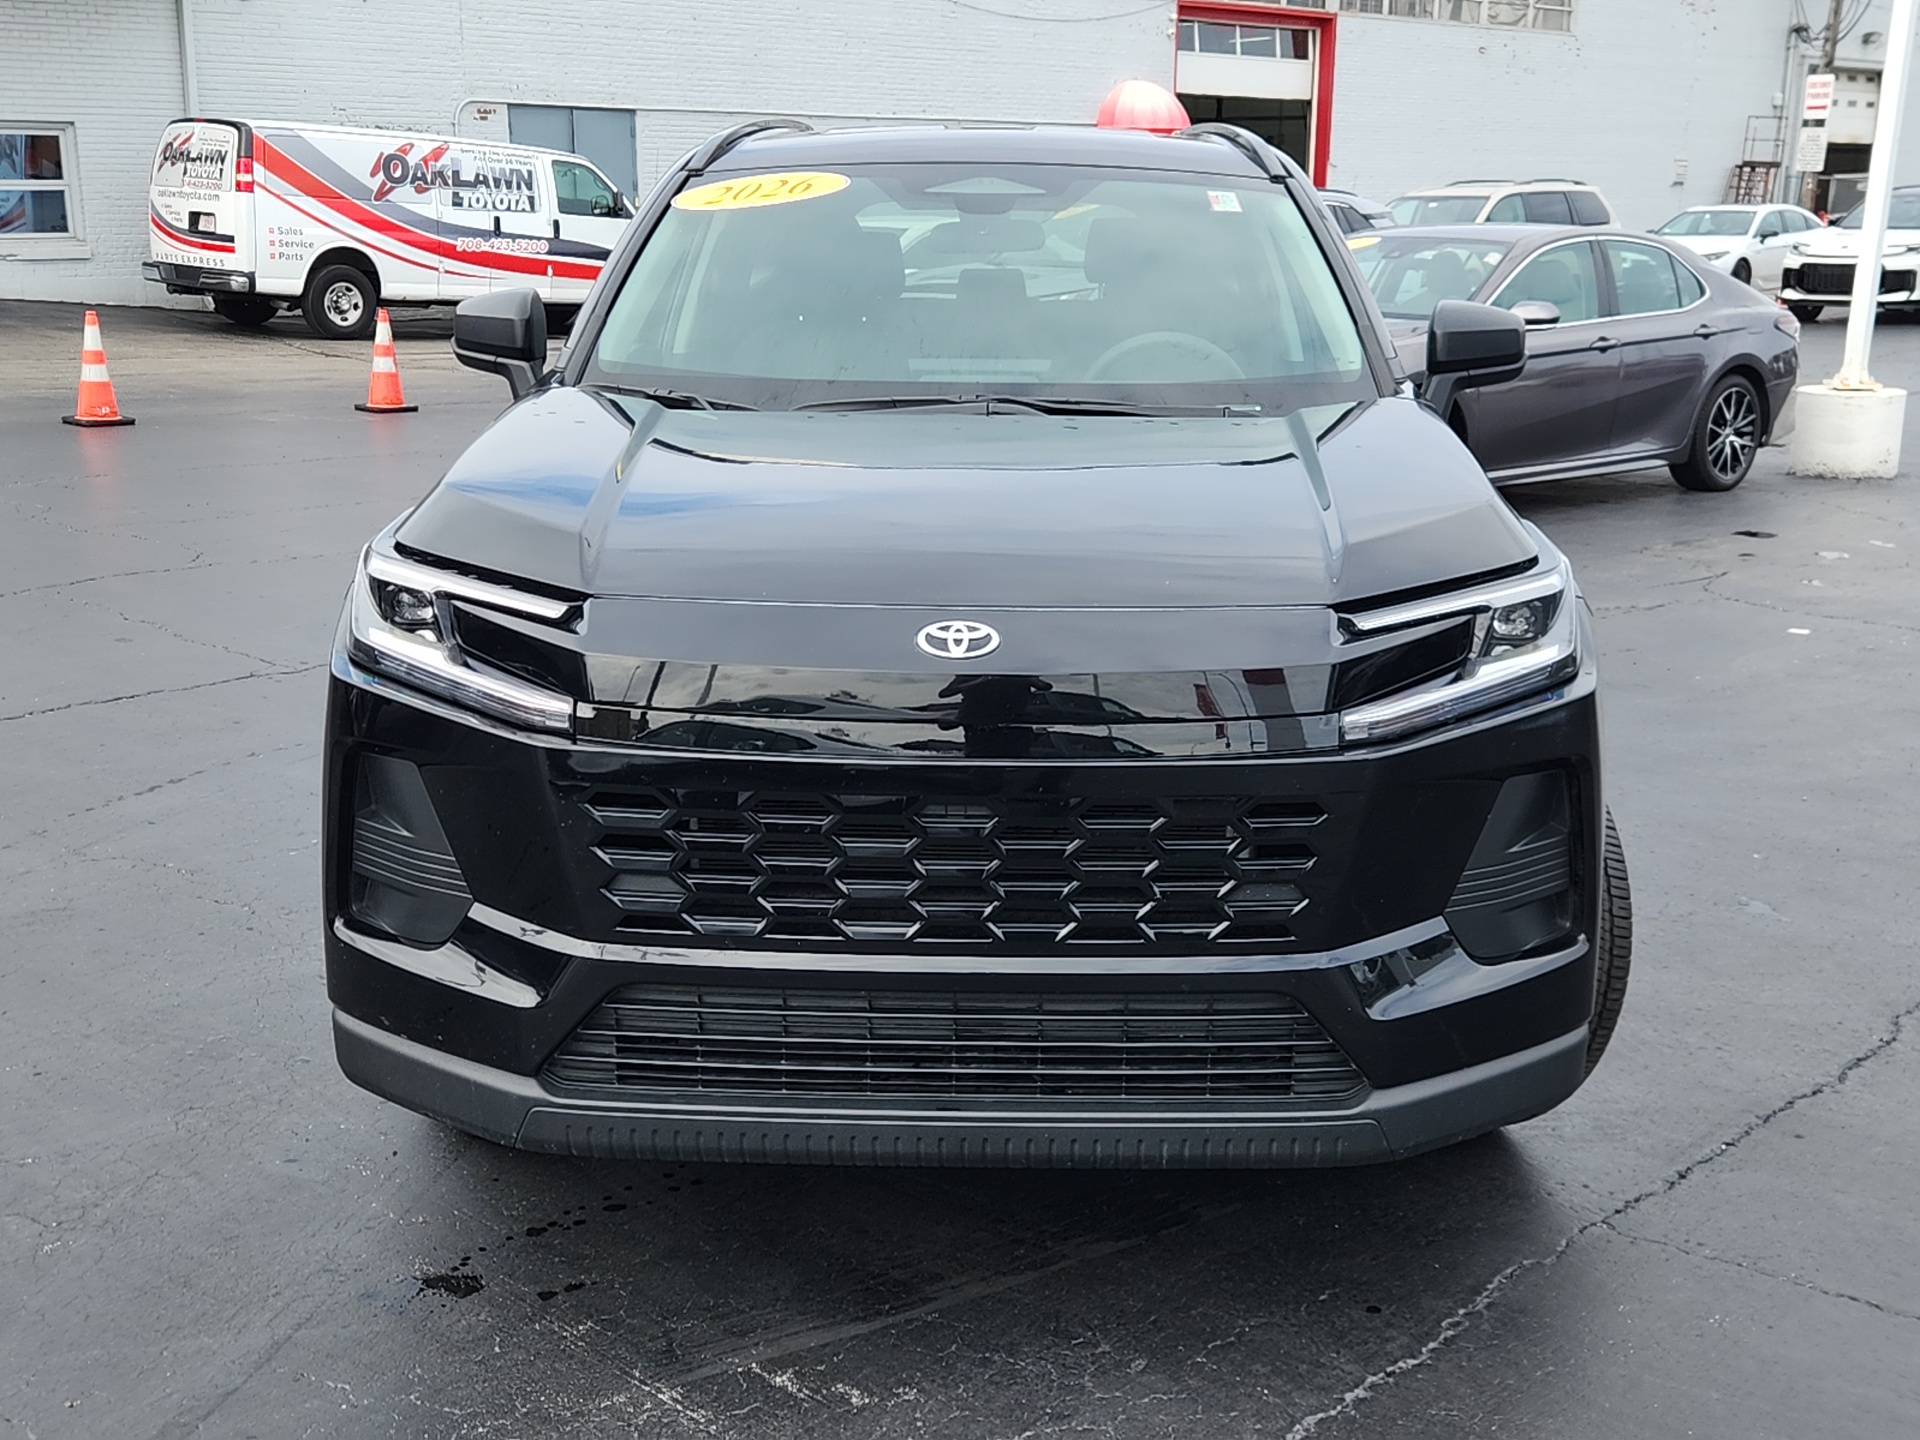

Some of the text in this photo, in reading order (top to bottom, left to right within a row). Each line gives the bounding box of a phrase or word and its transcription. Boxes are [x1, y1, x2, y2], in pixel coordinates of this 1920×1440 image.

[487, 156, 503, 164] Over
[186, 167, 221, 180] TOYOTA
[157, 189, 220, 201] oaklawntoyota.com
[703, 176, 821, 205] 2026
[459, 192, 532, 211] TOYOTA
[277, 226, 304, 236] Sales
[278, 239, 315, 249] Service
[458, 239, 548, 252] 708-423-5200
[155, 252, 225, 267] PARTS EXPRESS
[278, 251, 304, 261] Parts
